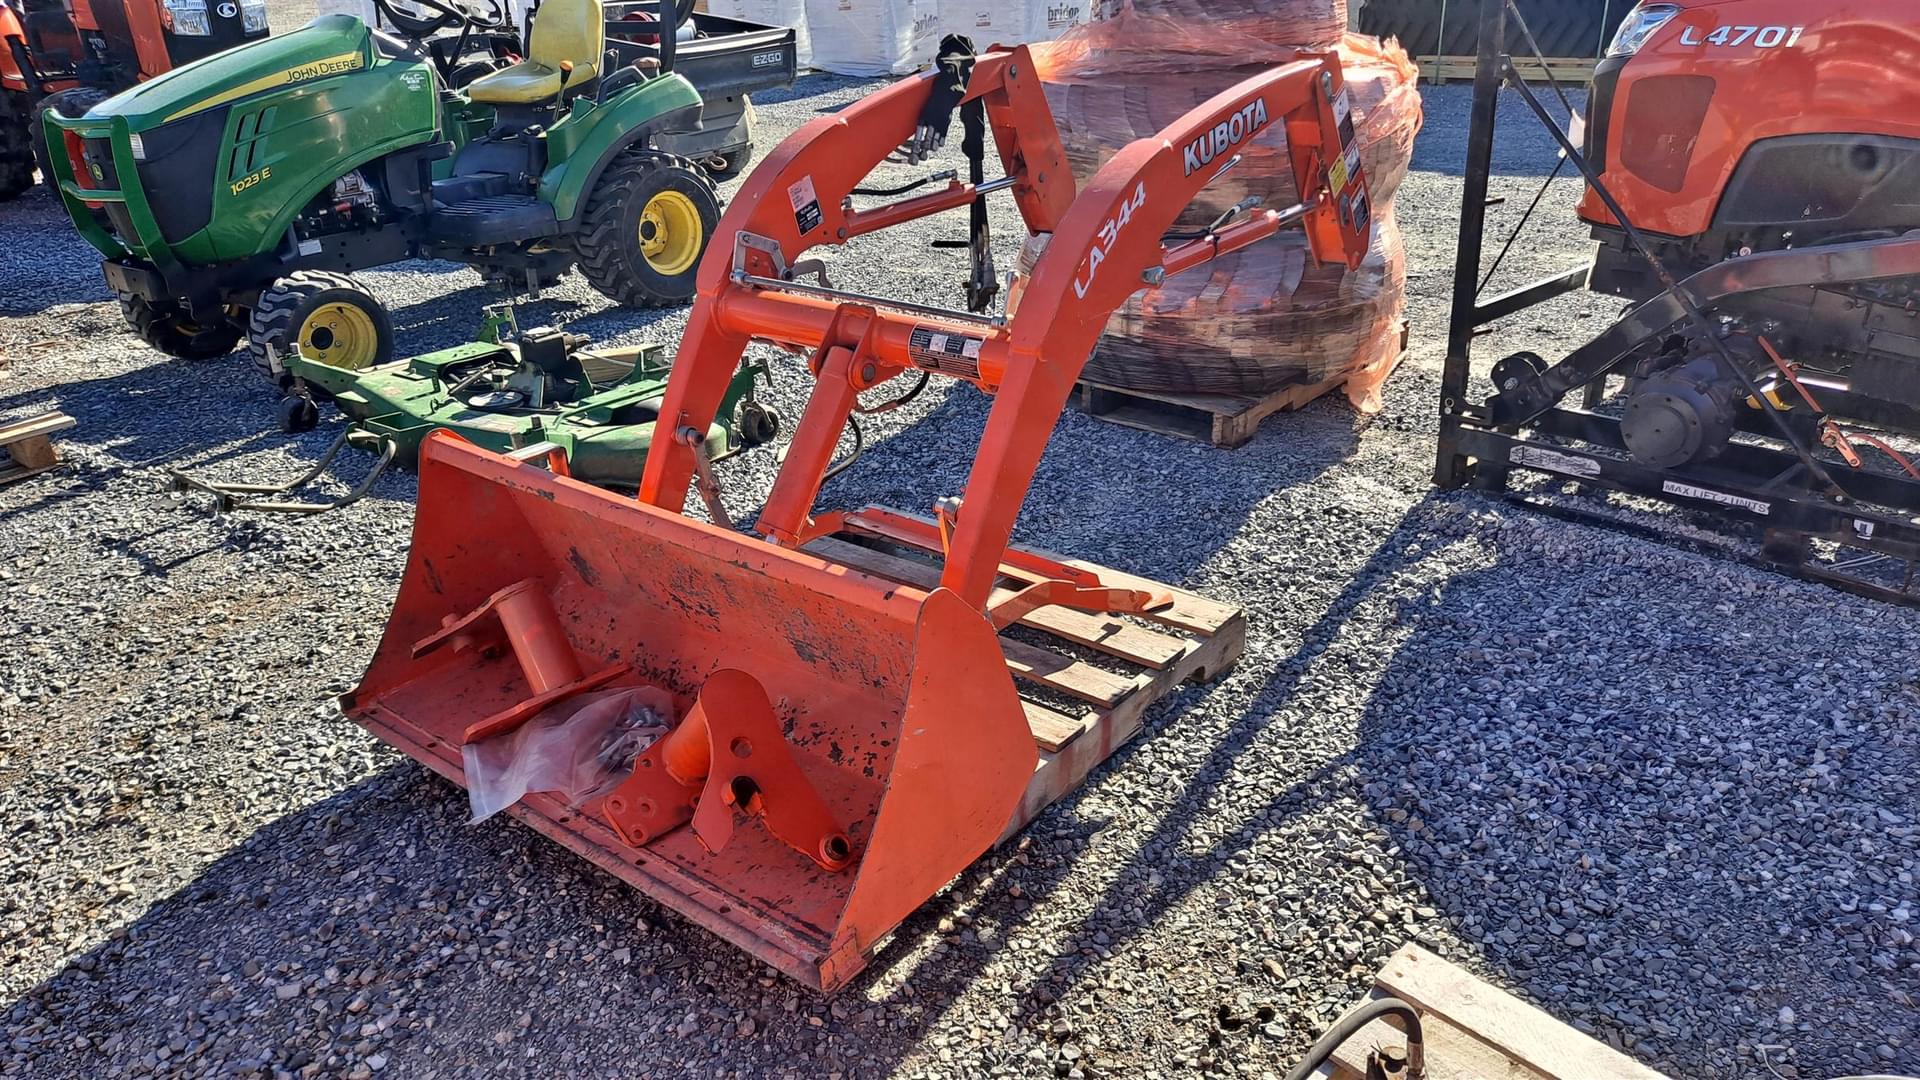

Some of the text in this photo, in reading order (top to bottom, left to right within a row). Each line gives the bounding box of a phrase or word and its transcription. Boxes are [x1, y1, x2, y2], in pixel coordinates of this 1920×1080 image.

[1680, 25, 1805, 48] L4701
[287, 60, 358, 82] JOHN DEERE
[1183, 97, 1269, 177] KUBOTA
[230, 166, 272, 196] 1023 E
[1074, 181, 1146, 299] LA344
[1664, 484, 1690, 495] MAX
